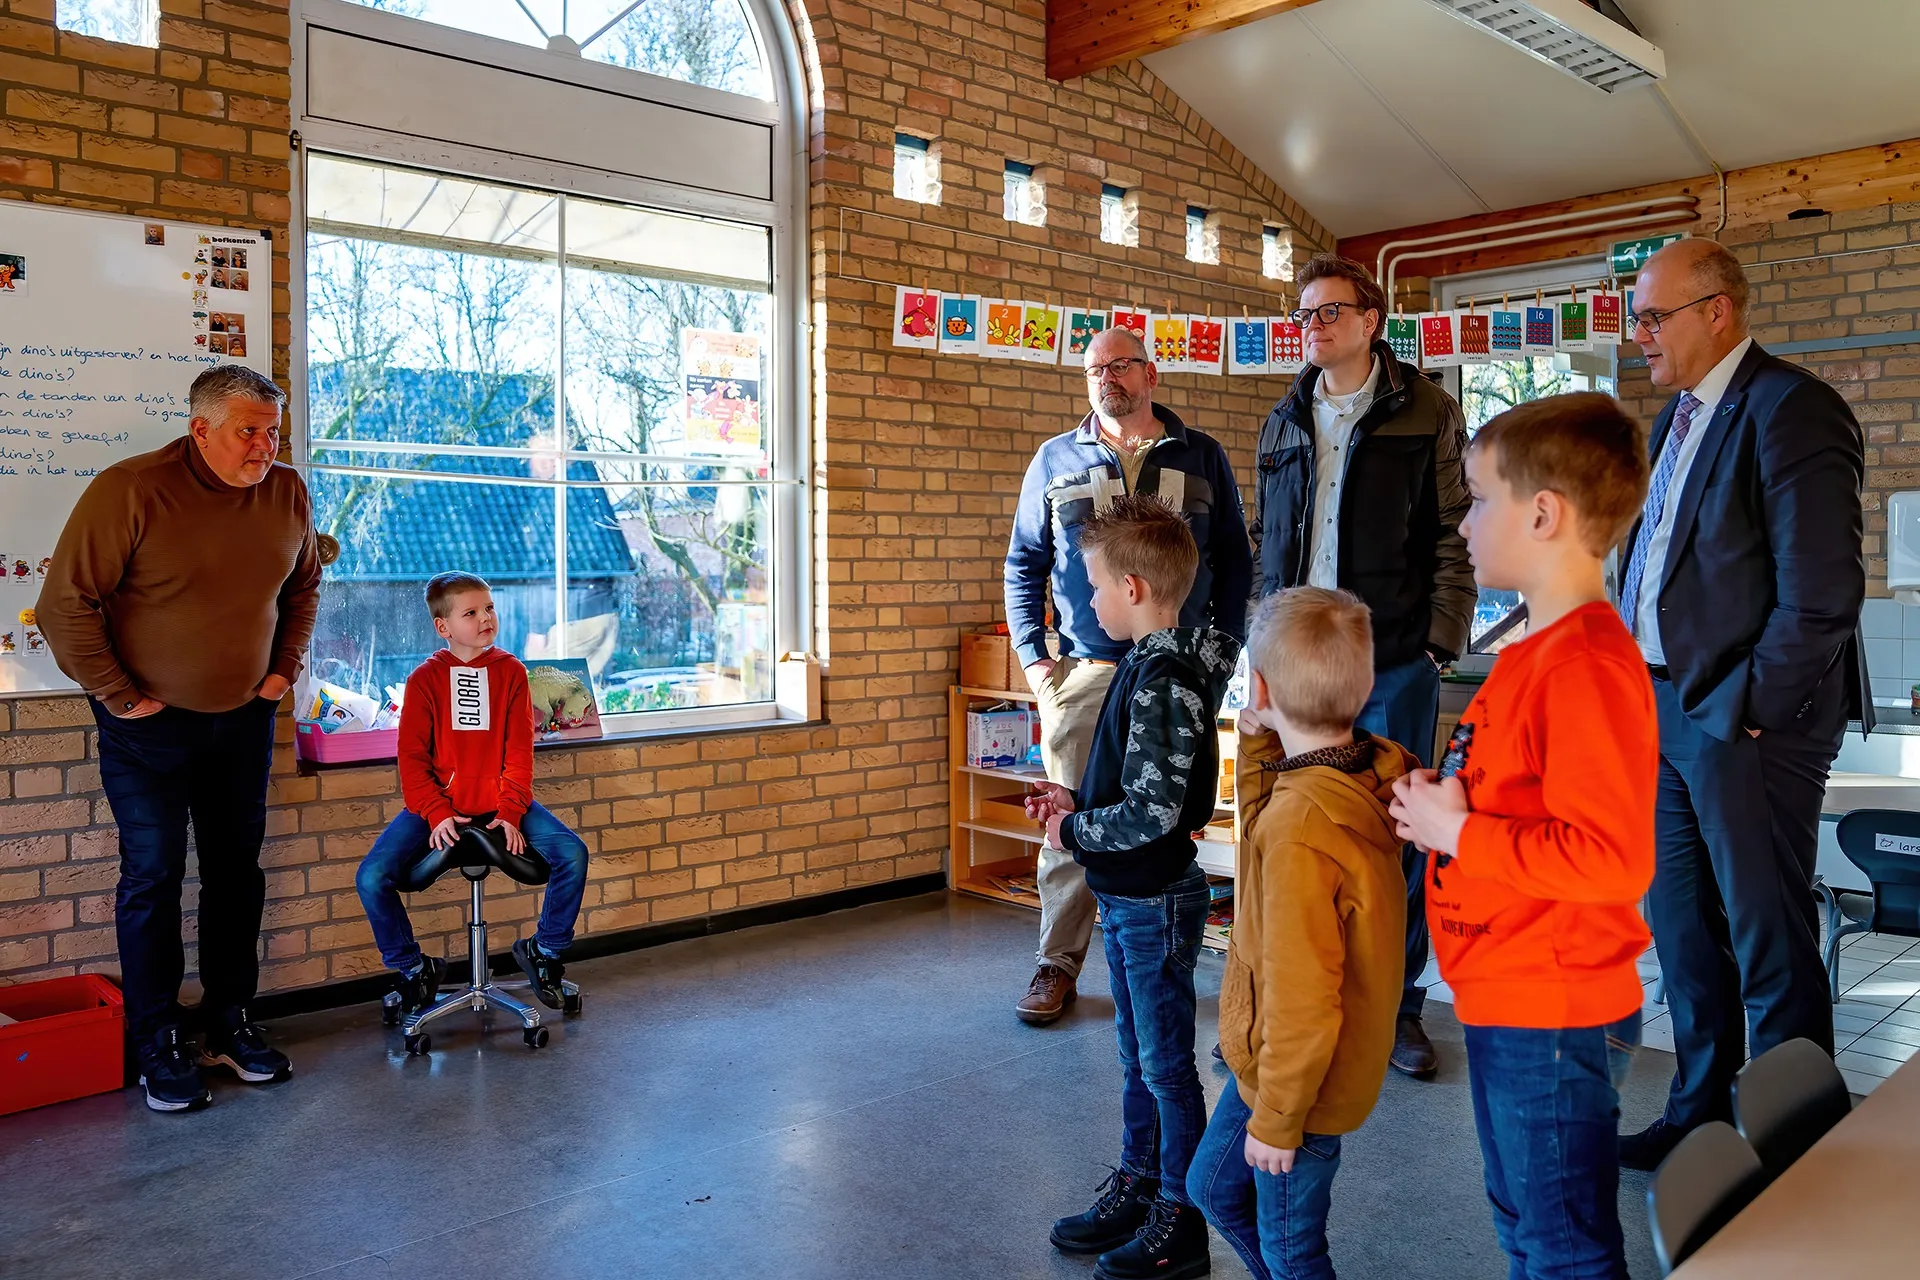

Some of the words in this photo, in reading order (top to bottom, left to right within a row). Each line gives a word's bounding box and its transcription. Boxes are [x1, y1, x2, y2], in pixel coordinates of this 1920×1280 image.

[211, 236, 257, 244] bofkonten
[916, 297, 925, 307] 0
[1601, 298, 1610, 308] 18
[1001, 308, 1009, 319] 2
[1570, 305, 1578, 315] 17
[1038, 312, 1046, 322] 3
[1502, 315, 1511, 324] 15
[1535, 311, 1545, 320] 16
[1083, 318, 1092, 328] 4
[1126, 316, 1134, 326] 5
[1431, 320, 1441, 330] 13
[1469, 318, 1479, 328] 14
[1166, 323, 1174, 333] 6
[1202, 324, 1209, 335] 7
[1246, 325, 1254, 336] 8
[1283, 325, 1290, 335] 9
[1397, 322, 1407, 332] 12
[20, 345, 56, 357] dino's
[60, 346, 144, 365] uitgestorven?
[150, 352, 162, 360] en
[167, 352, 192, 363] hoe
[194, 354, 221, 368] lang?
[18, 367, 75, 387] dino's?
[16, 390, 37, 401] de
[39, 392, 97, 402] tanden
[103, 394, 127, 403] van
[134, 392, 176, 406] dino's
[22, 408, 73, 422] dino's?
[35, 429, 53, 440] ze
[61, 431, 129, 447] geleefd?
[27, 464, 42, 476] in
[47, 464, 68, 475] het
[457, 671, 481, 727] GLOBAL
[1899, 841, 1920, 853] lars
